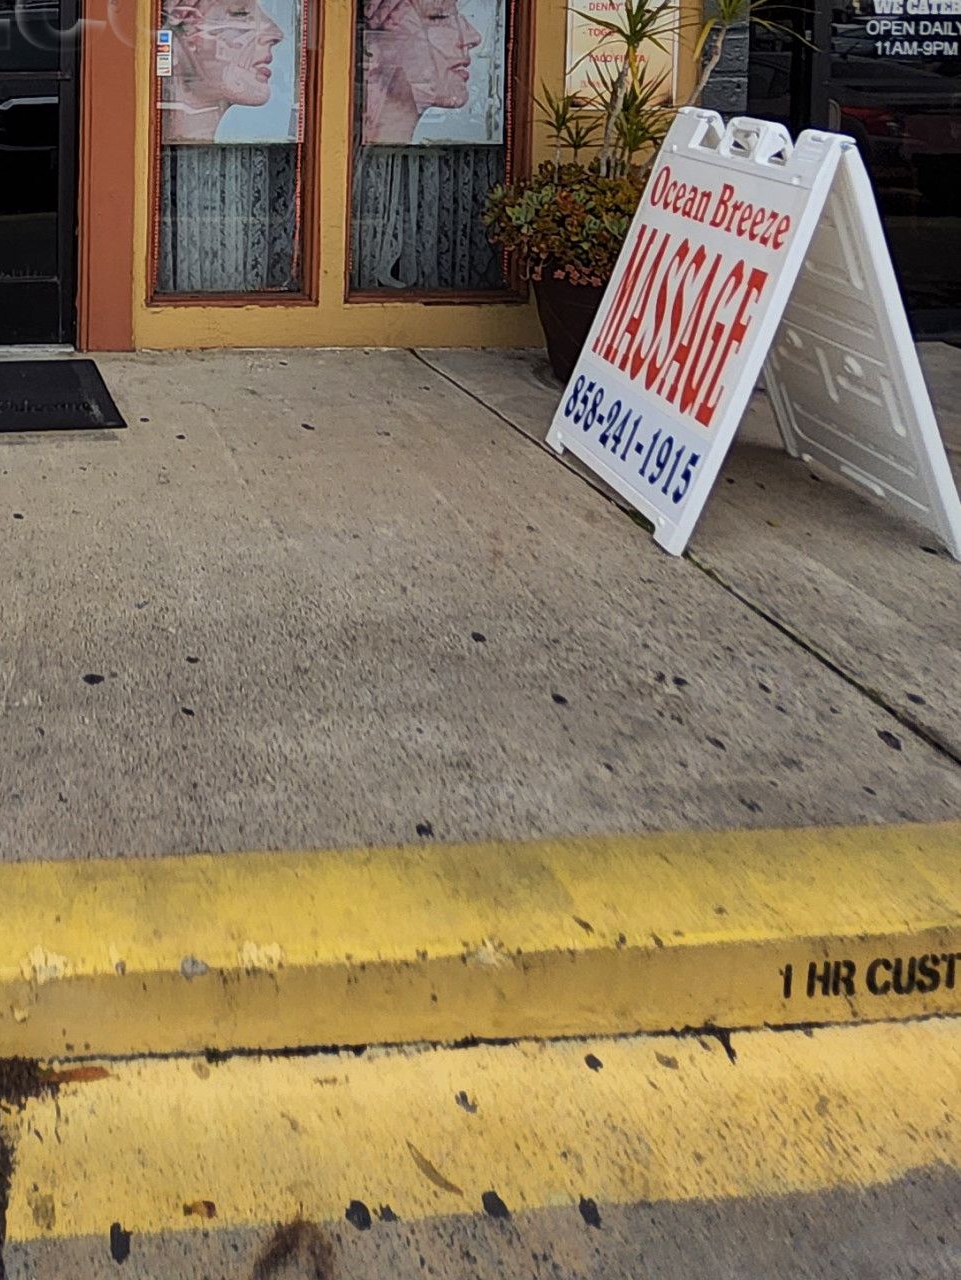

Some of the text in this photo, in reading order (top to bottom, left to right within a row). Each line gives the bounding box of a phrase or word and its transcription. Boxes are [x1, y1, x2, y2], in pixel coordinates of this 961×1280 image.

[866, 20, 916, 36] OPEN
[875, 41, 959, 56] 11AM-9PM
[614, 53, 647, 63] FITA
[649, 164, 791, 251] Ocean Breeze
[590, 223, 769, 428] MASSAGE
[563, 374, 701, 505] 858-241-1915
[779, 952, 961, 999] 1 HR CUST
